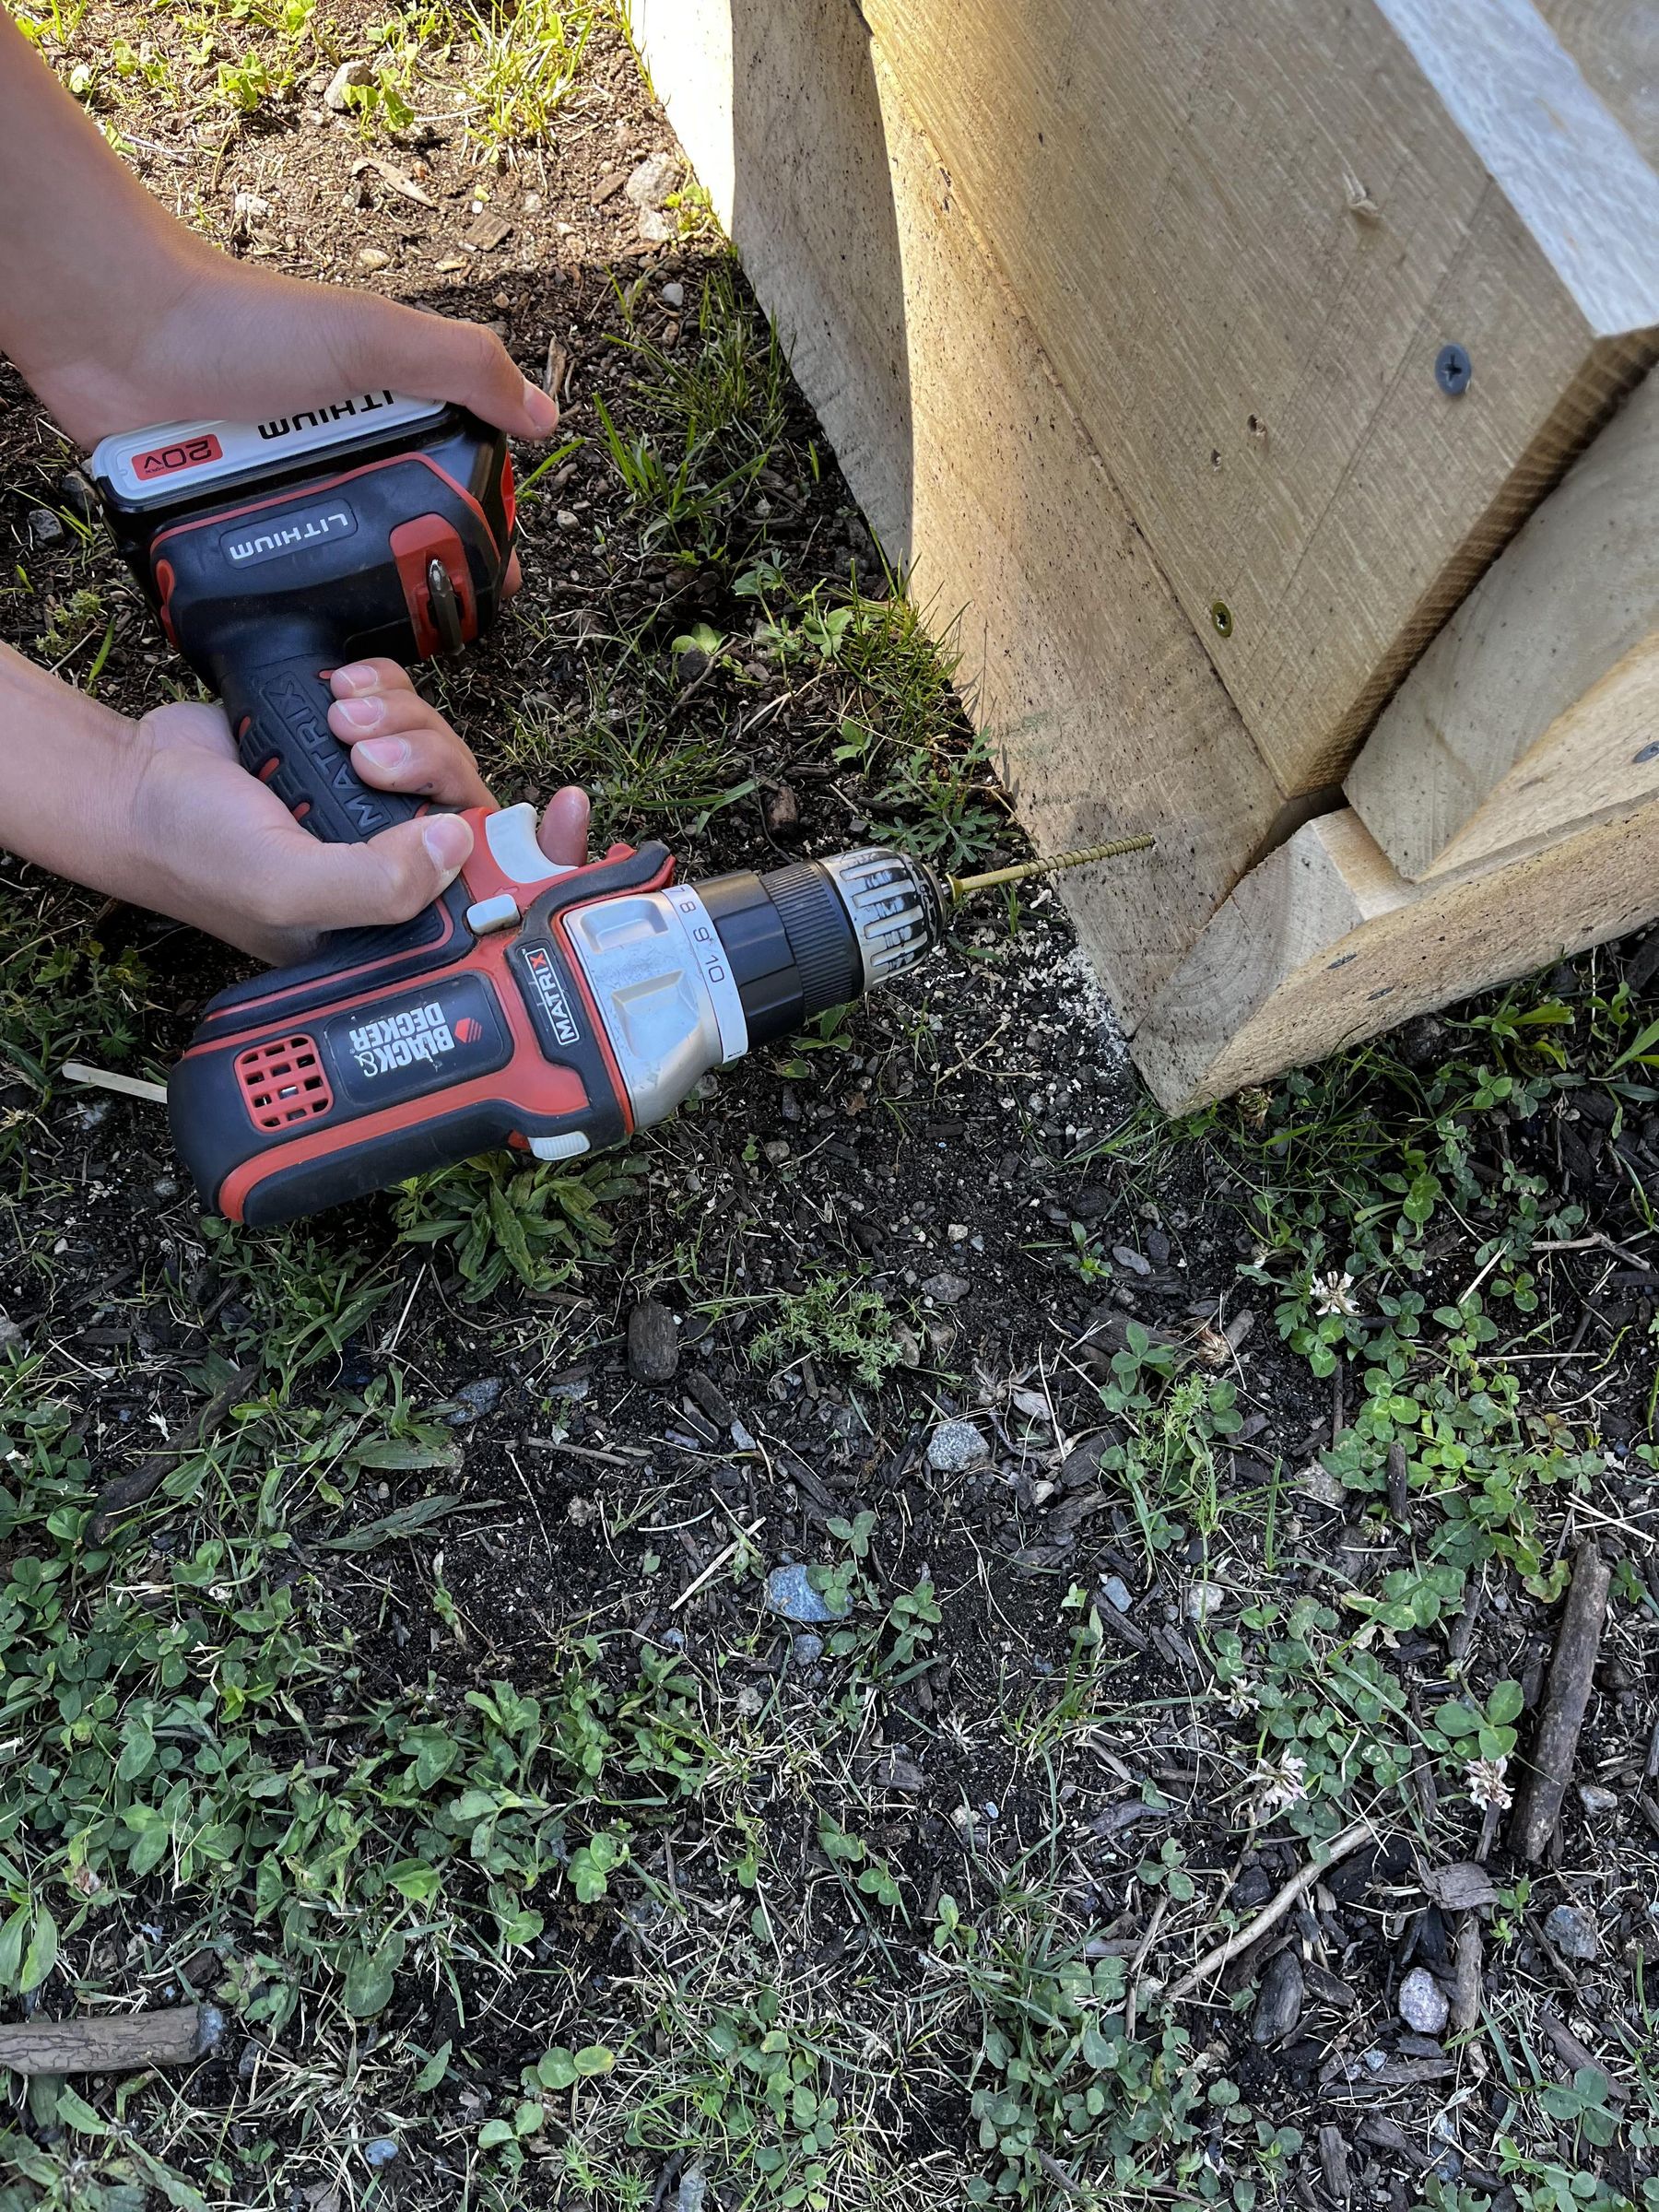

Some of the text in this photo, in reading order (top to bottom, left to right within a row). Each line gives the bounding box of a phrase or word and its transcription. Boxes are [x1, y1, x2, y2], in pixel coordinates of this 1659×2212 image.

[257, 390, 394, 440] ITHIUM
[144, 440, 212, 469] 20V
[229, 512, 349, 560] LITHIUM
[274, 679, 383, 829] MATRIX
[679, 900, 697, 913] 8
[692, 925, 711, 943] 9
[705, 954, 725, 983] 10
[529, 951, 575, 1041] MATRIX
[348, 1002, 446, 1052] DECKER
[372, 1024, 455, 1073] BLACK
